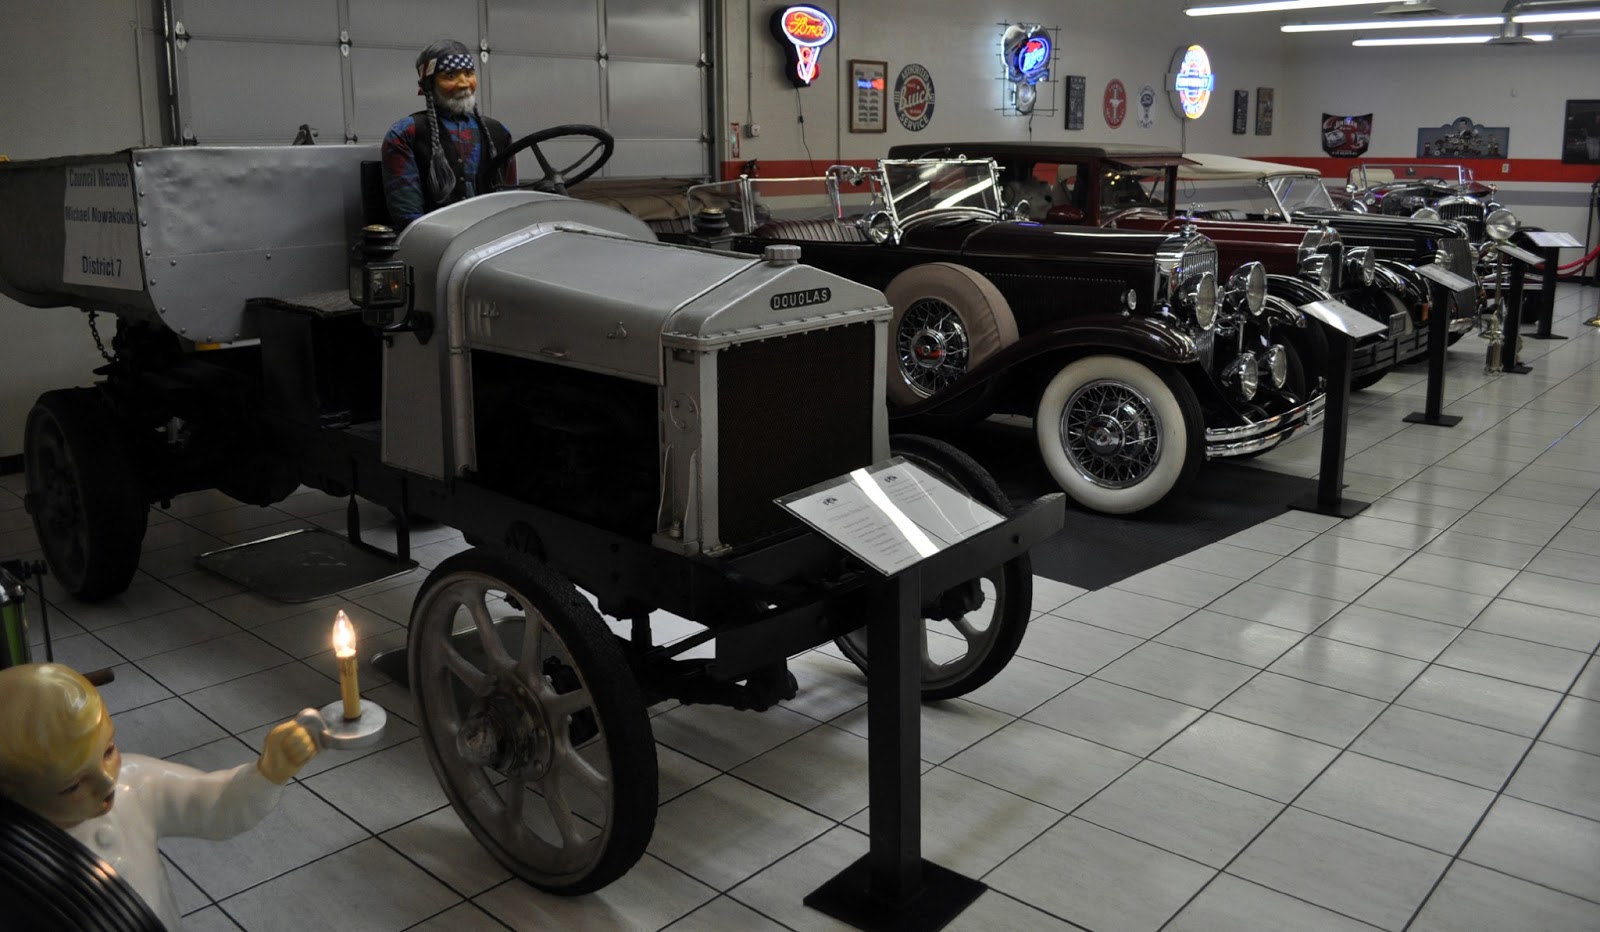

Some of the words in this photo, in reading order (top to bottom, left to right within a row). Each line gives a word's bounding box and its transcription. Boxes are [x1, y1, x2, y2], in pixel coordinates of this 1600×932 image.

[788, 11, 826, 37] Ford
[899, 82, 933, 111] Buick
[900, 113, 929, 131] SERVICE
[69, 168, 97, 187] Council
[98, 169, 130, 188] Member
[65, 206, 90, 222] Michael
[91, 207, 136, 225] Nowakowski
[82, 255, 115, 276] District
[116, 259, 122, 277] 7
[773, 289, 828, 308] DOUGLAS
